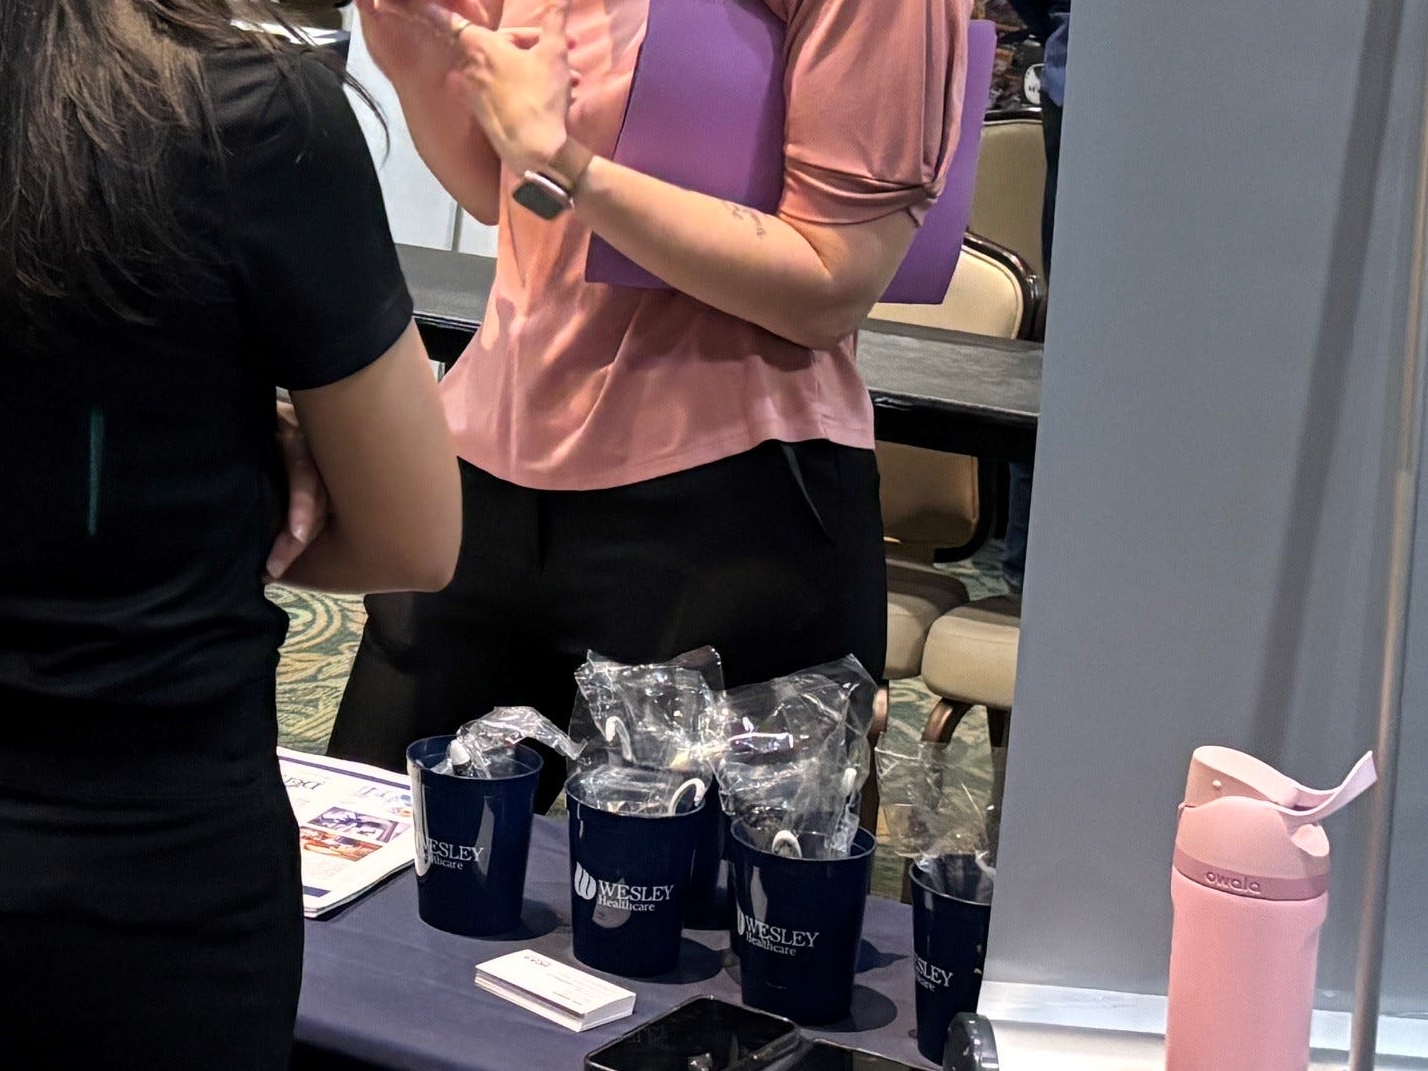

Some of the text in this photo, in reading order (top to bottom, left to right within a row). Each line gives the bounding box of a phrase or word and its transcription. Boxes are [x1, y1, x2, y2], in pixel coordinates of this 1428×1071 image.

[598, 879, 675, 902] WESLEY
[1204, 871, 1262, 895] owala
[598, 894, 655, 912] Healthcare
[744, 915, 819, 948] WESLEY
[746, 931, 797, 956] Healthcare
